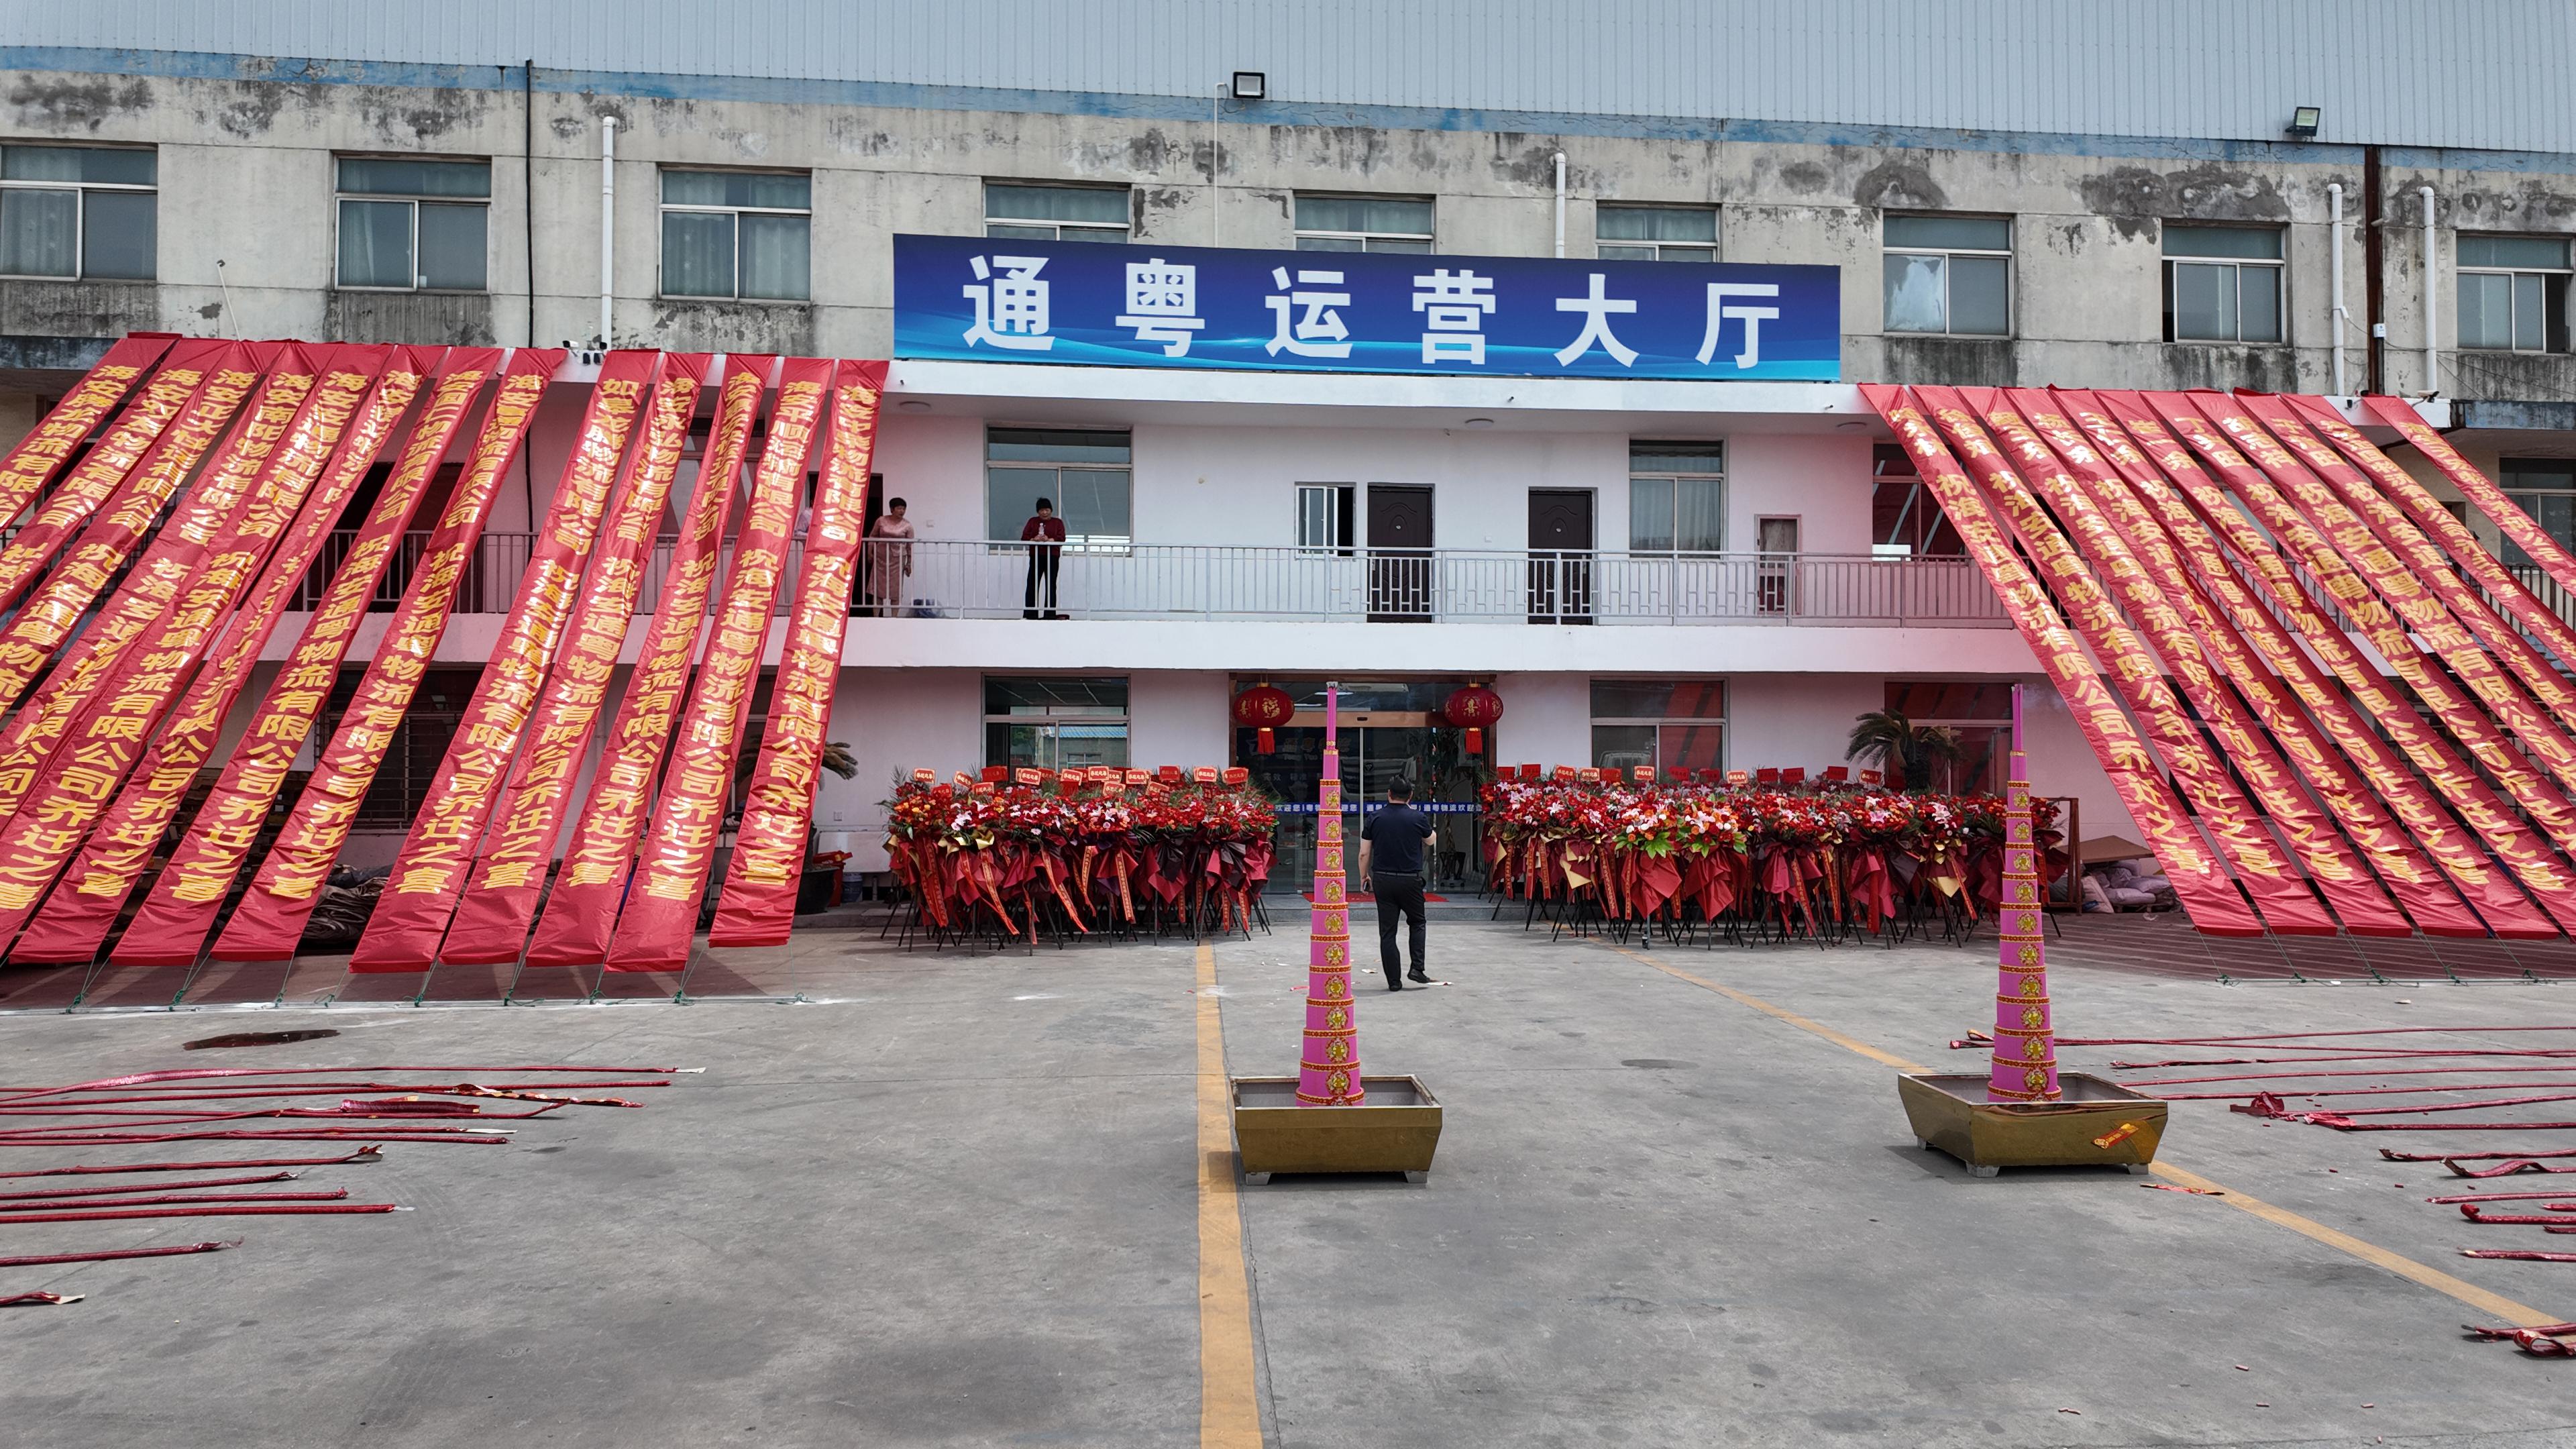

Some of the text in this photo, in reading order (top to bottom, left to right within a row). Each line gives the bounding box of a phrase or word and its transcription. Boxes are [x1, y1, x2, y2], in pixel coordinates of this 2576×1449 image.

[962, 256, 1782, 370] 通粤运营大厅
